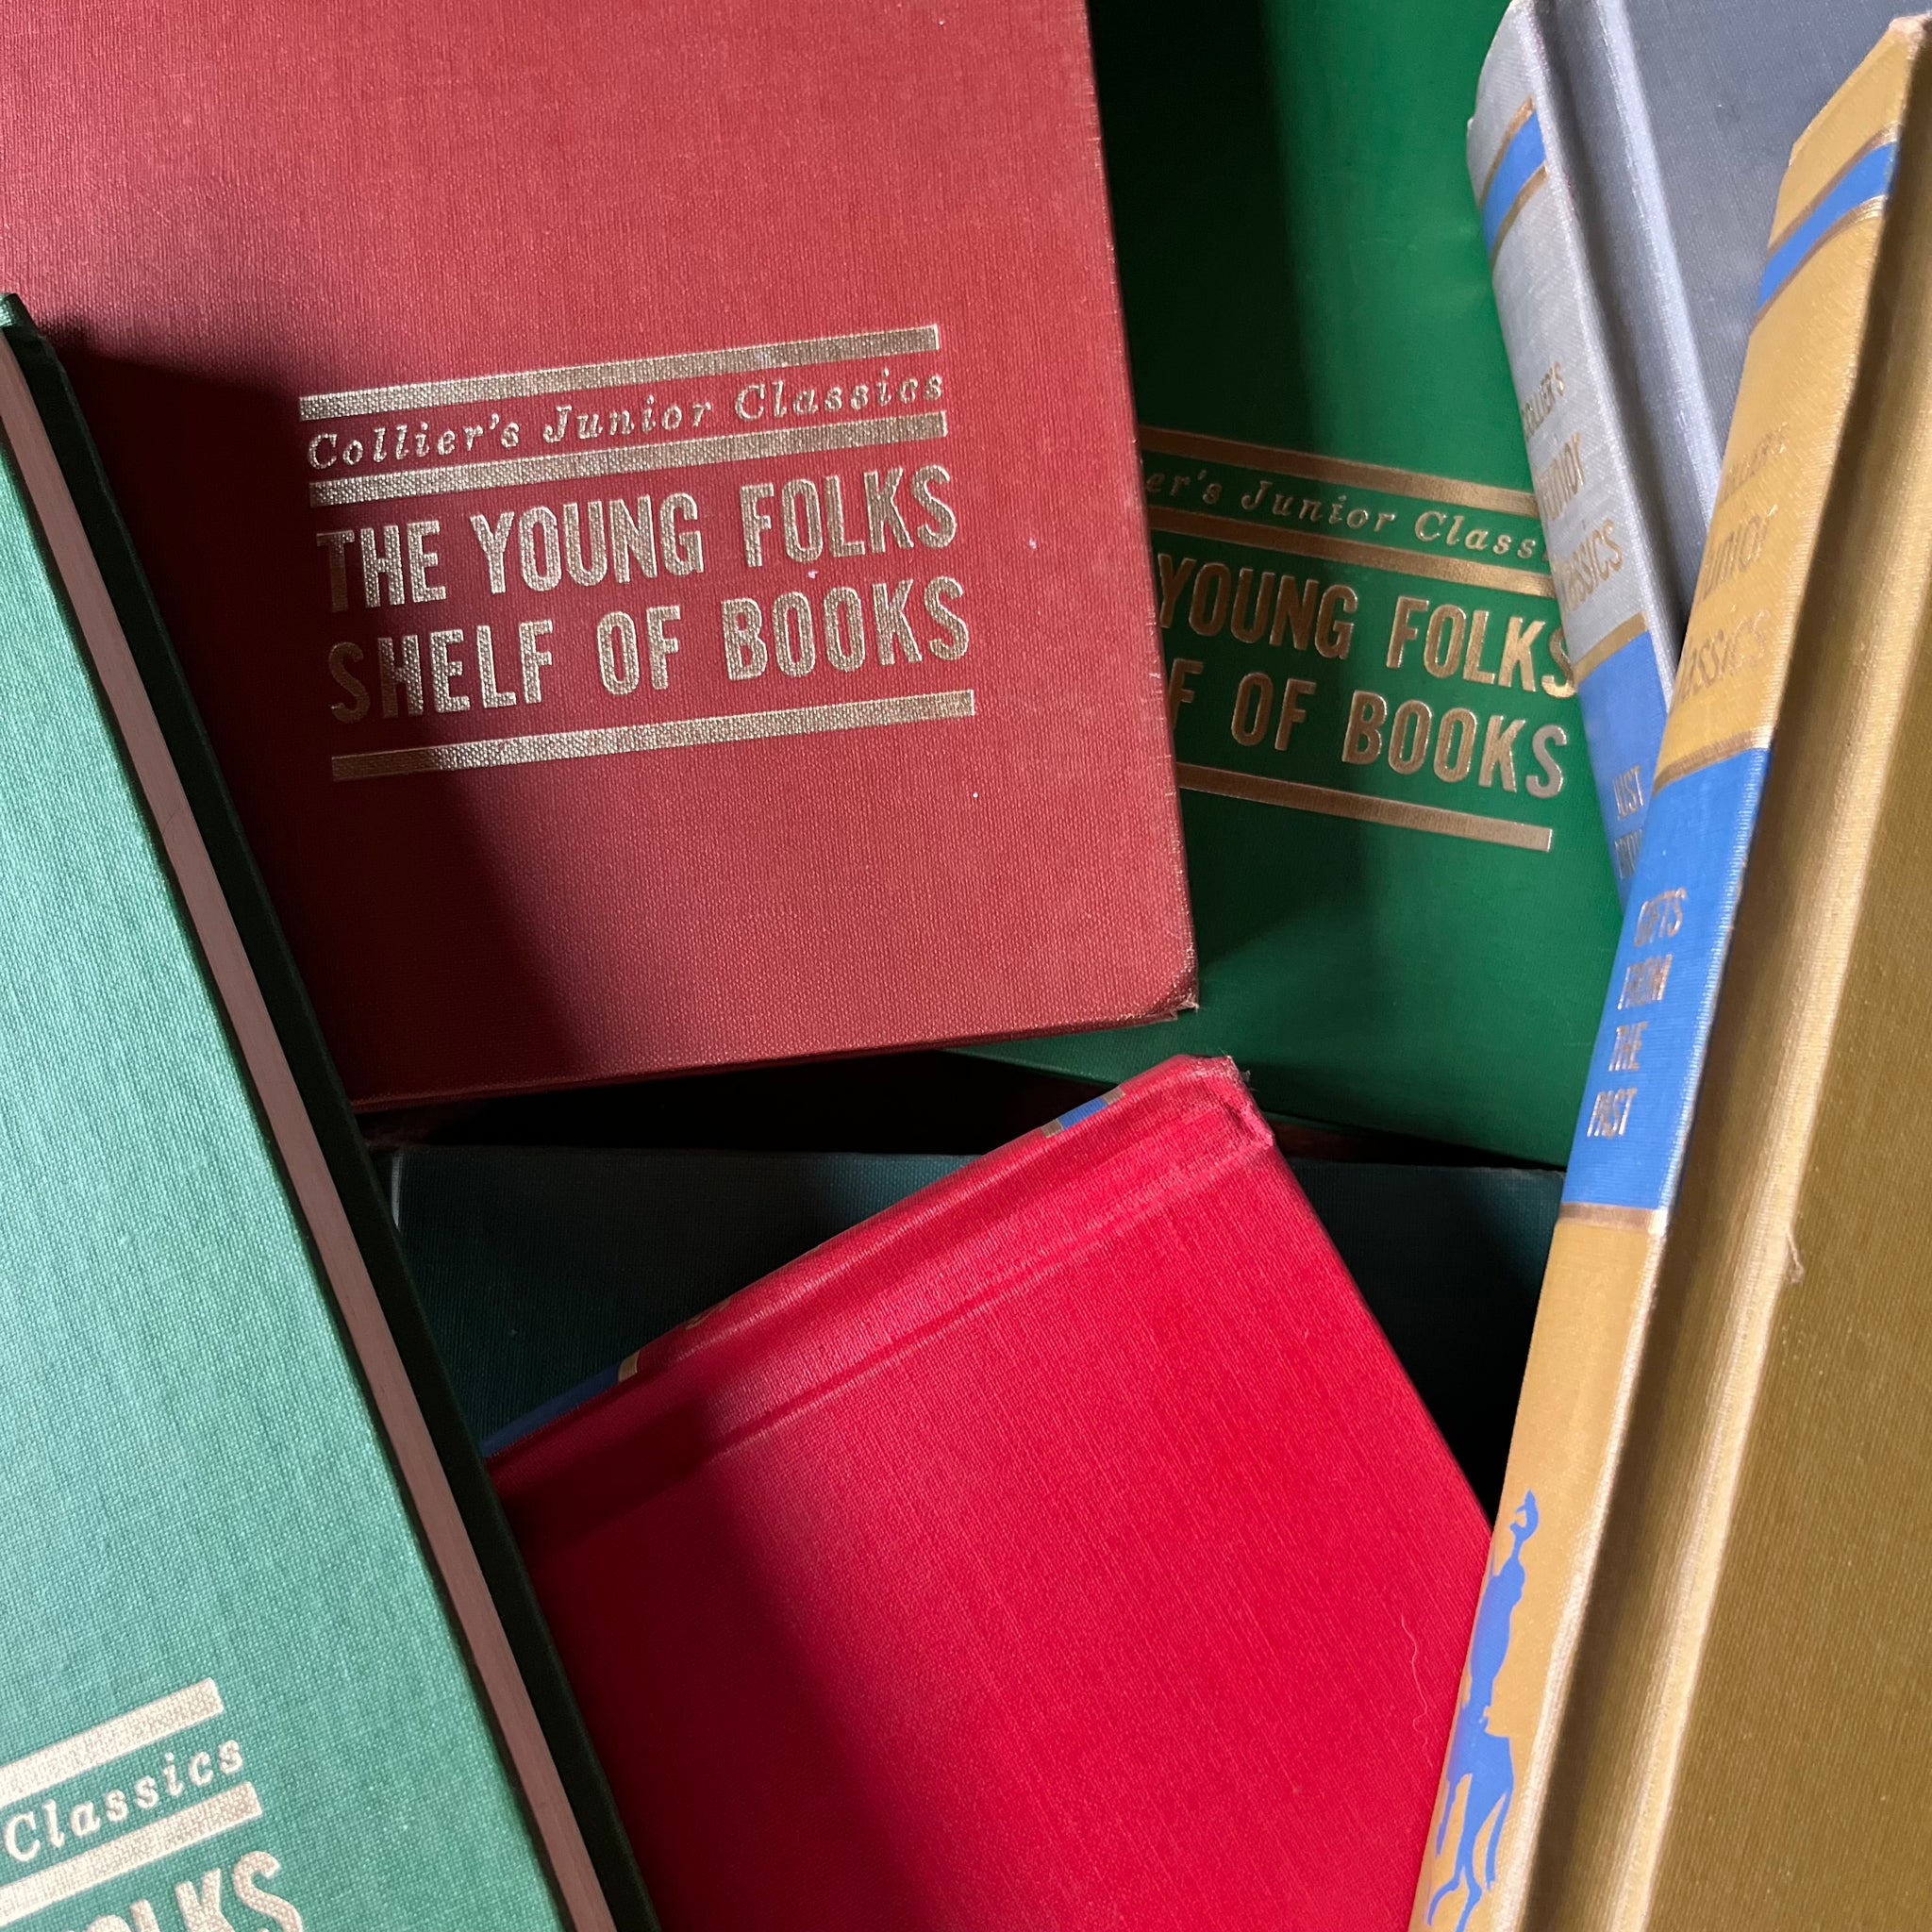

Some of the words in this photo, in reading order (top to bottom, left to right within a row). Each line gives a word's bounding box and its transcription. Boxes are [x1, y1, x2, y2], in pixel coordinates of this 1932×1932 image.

[308, 413, 519, 470] Collier's
[542, 394, 711, 443] Junior
[734, 368, 942, 422] Classics
[316, 520, 447, 613] THE
[470, 491, 705, 594] YOUNG
[740, 464, 958, 568] FOLKS
[1241, 480, 1397, 532] Junior
[1415, 510, 1549, 560] Class
[330, 619, 554, 724] SHELF
[596, 605, 680, 696] OF
[721, 576, 970, 681] BOOKS
[1158, 553, 1358, 660] YOUNG
[1386, 596, 1576, 699] FOLKS
[1231, 673, 1317, 751] OF
[1342, 690, 1569, 800] BOOKS
[1608, 1022, 1648, 1073] THE
[1587, 1088, 1638, 1140] PAST
[3, 1740, 244, 1862] Classics
